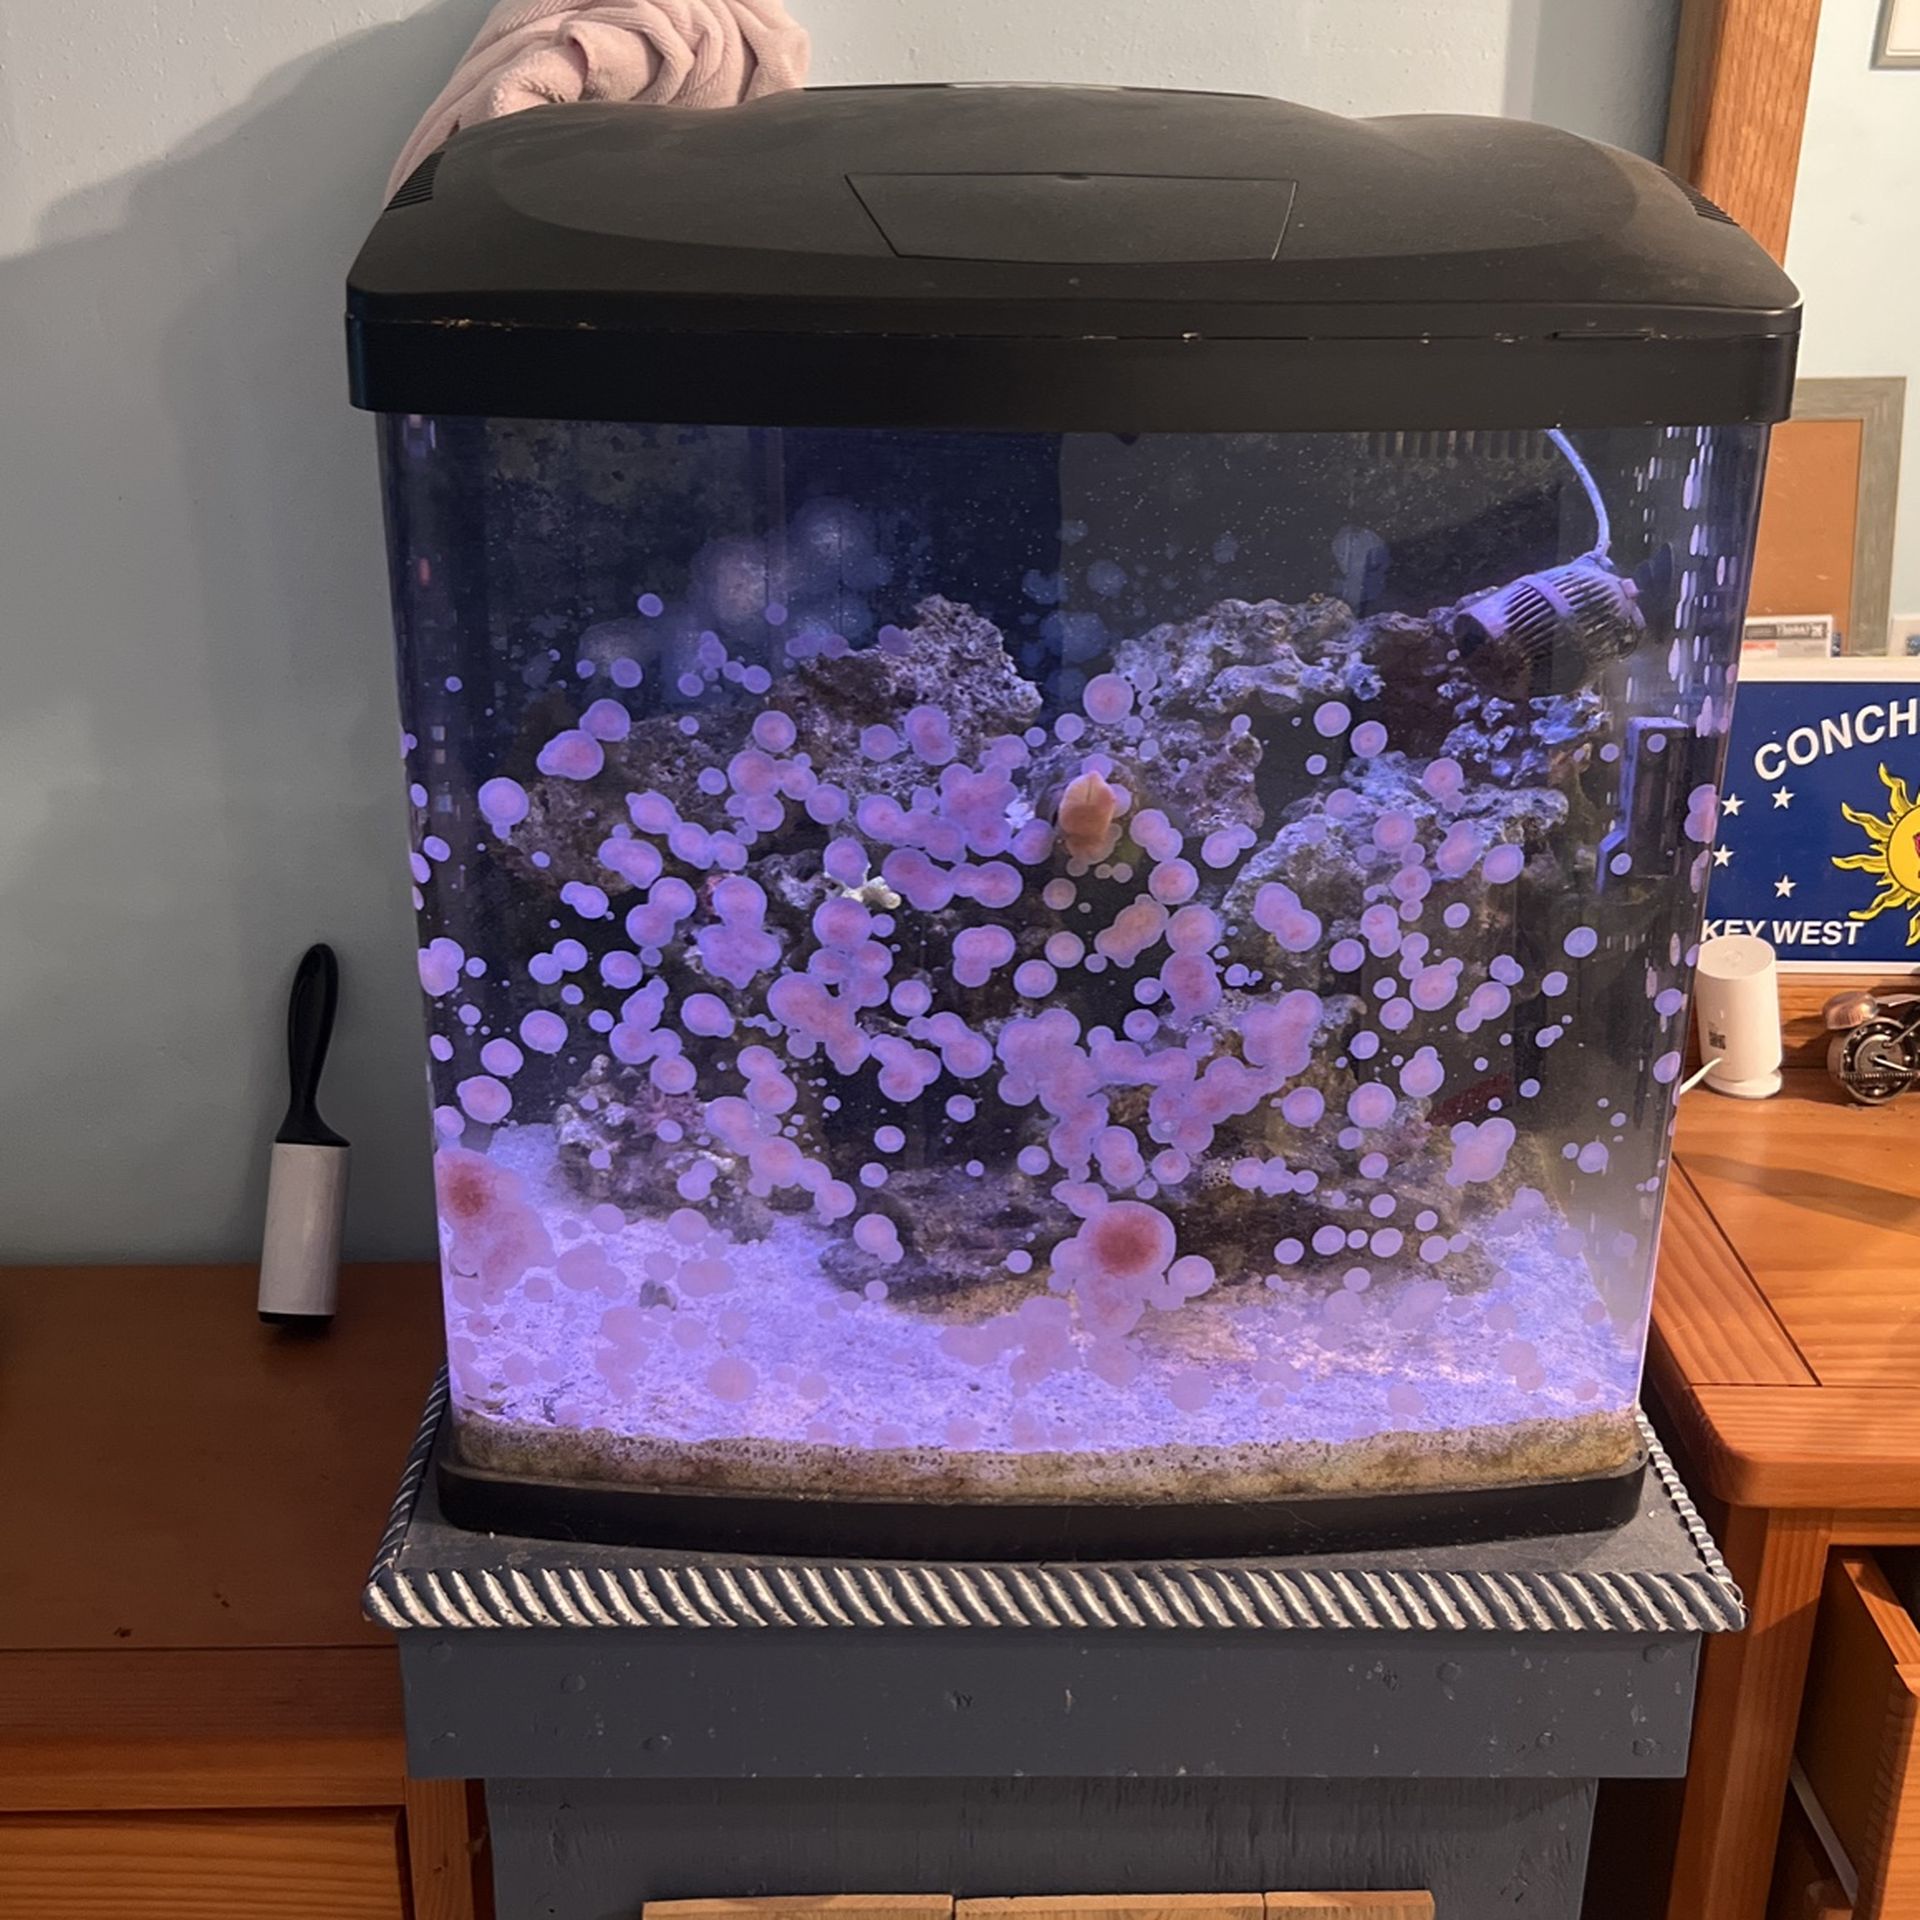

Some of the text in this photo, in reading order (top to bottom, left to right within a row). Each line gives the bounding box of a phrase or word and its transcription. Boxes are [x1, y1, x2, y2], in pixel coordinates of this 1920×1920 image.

[1754, 698, 1917, 781] CONCH
[1701, 919, 1865, 945] KEY WEST
